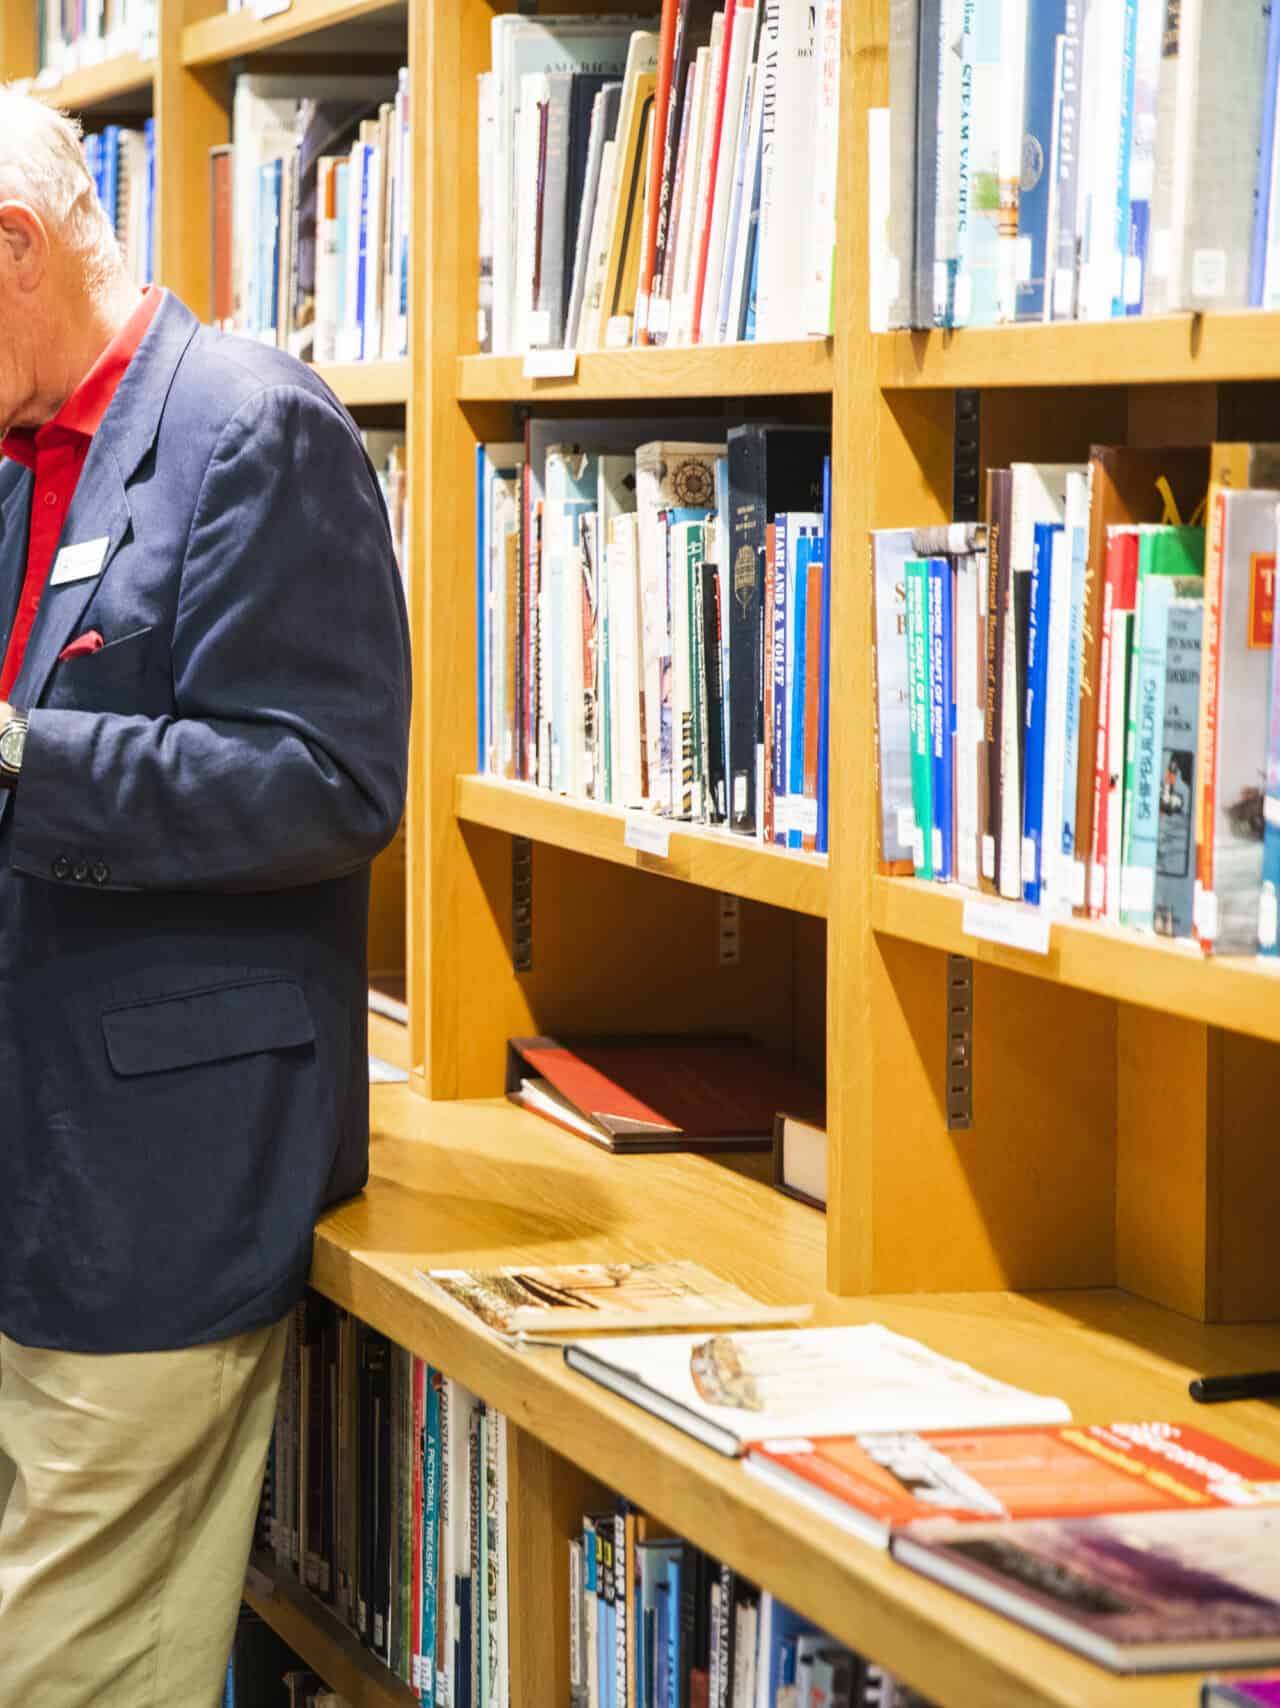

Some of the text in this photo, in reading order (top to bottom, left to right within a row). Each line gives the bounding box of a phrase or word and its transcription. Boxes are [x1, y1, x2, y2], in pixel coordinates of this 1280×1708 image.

[763, 51, 778, 153] MODELS
[958, 64, 972, 233] STEAM YACHTS
[774, 526, 785, 605] HARLAND
[989, 523, 999, 609] Traditional
[774, 608, 785, 624] &
[773, 627, 785, 687] WOLFF
[987, 664, 996, 686] of
[985, 687, 995, 744] Ireland
[1138, 679, 1156, 820] SHIPBUILDING
[441, 1392, 450, 1456] COASTAL
[423, 1434, 435, 1586] A PICTORIAL TREASURY
[440, 1463, 450, 1527] PASSAGE
[614, 1514, 625, 1595] GREAT
